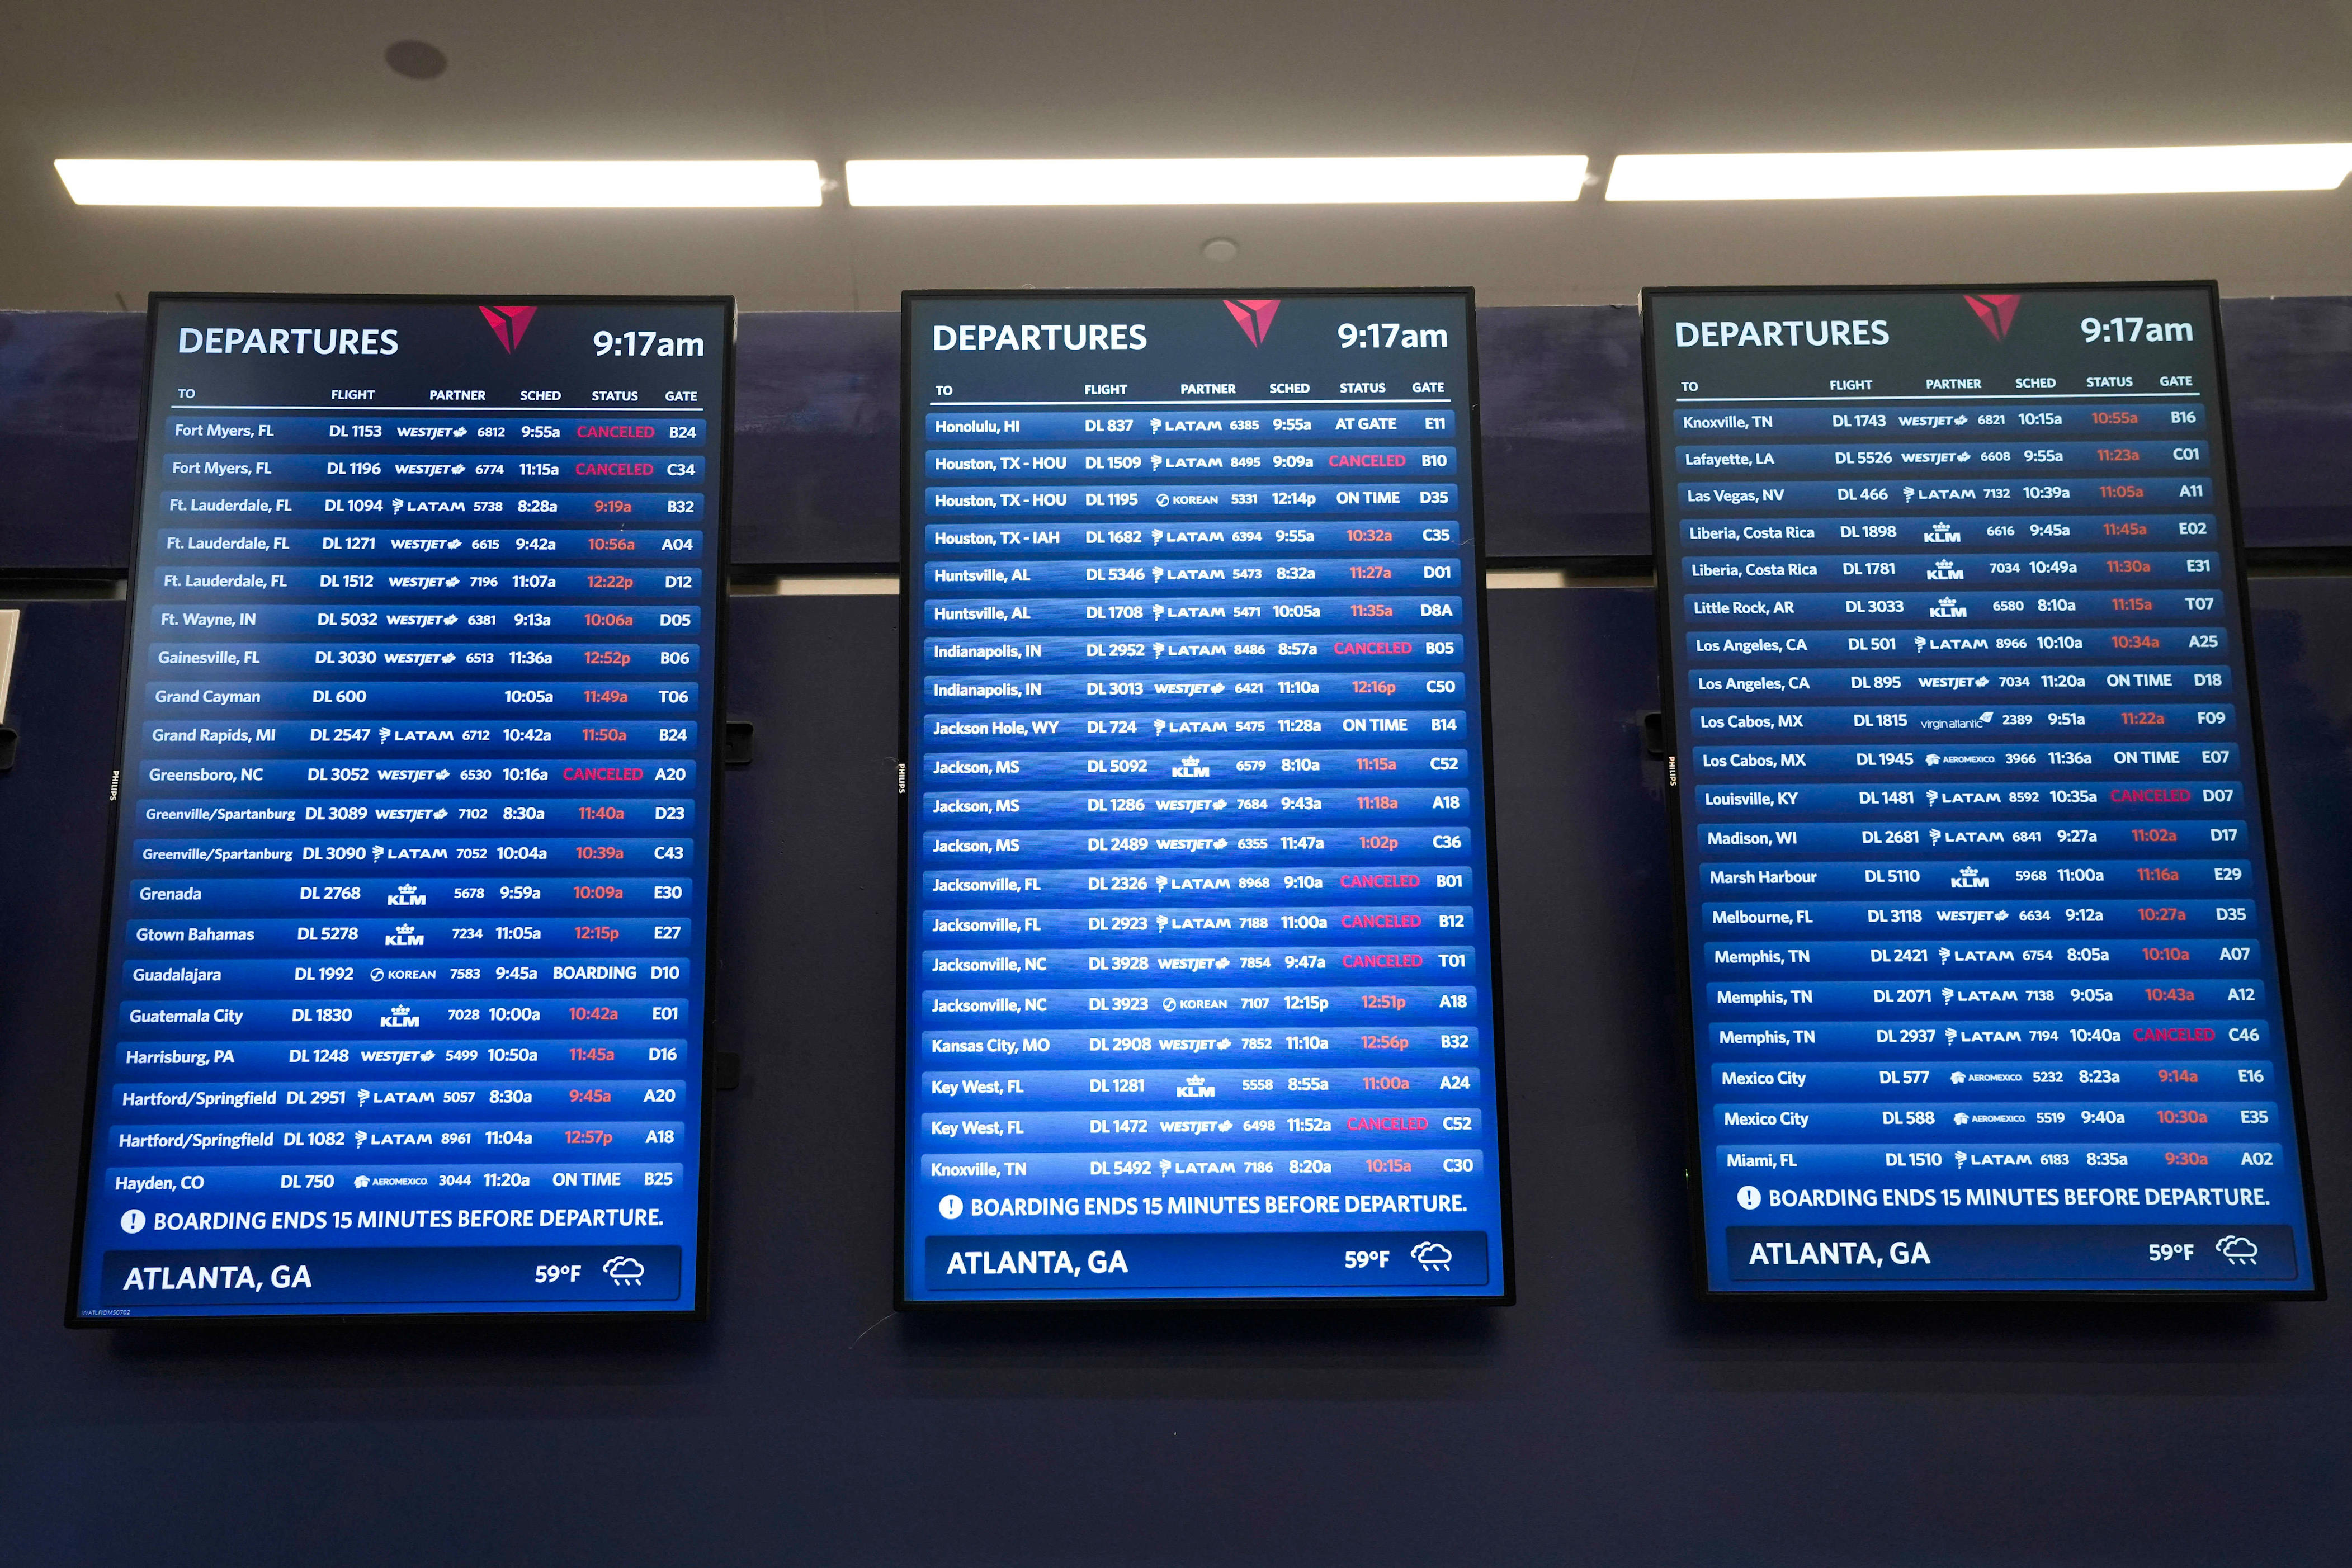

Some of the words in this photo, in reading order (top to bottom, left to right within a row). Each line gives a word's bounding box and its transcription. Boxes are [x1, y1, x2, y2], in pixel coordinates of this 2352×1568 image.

[933, 324, 1147, 351] DEPARTURES
[1338, 323, 1448, 349] 9:17am
[1676, 319, 1890, 347] DEPARTURES
[2081, 317, 2193, 343] 9:17am
[179, 328, 398, 355] DEPARTURES
[593, 330, 704, 357] 9:17am
[935, 385, 953, 396] TO
[1084, 384, 1128, 395] FLIGHT
[1180, 384, 1236, 394] PARTNER
[1269, 383, 1310, 394] SCHED
[1340, 382, 1386, 393] STATUS
[1412, 382, 1445, 393] GATE
[1680, 381, 1698, 391] TO
[1830, 380, 1873, 390] FLIGHT
[1926, 379, 1982, 389] PARTNER
[2015, 377, 2056, 388] SCHED
[2086, 376, 2133, 388] STATUS
[2160, 376, 2193, 386] GATE
[178, 388, 196, 399] TO
[331, 389, 376, 400] FLIGHT
[429, 390, 486, 400] PARTNER
[520, 390, 561, 401] SCHED
[592, 391, 639, 401] STATUS
[665, 391, 698, 402] GATE
[1683, 415, 1749, 430] Knoxville,
[1751, 415, 1773, 428] TN
[1833, 414, 1852, 427] DL
[1854, 414, 1887, 427] 1743
[1898, 415, 1953, 429] WESTJET
[1977, 414, 2005, 425] 6821
[2018, 413, 2062, 425] 10:15a
[2092, 412, 2138, 424] 10:55a
[2171, 411, 2197, 423] B16
[935, 457, 997, 472] Houston,
[999, 457, 1021, 470] TX
[1032, 456, 1067, 470] HOU
[1085, 456, 1105, 469] DL
[1107, 456, 1142, 469] 1509
[1165, 457, 1224, 468] LATAM
[1230, 457, 1261, 467] 8495
[1272, 455, 1314, 468] 9:09a
[1329, 454, 1406, 467] CANCELED
[1421, 454, 1447, 467] B10
[169, 499, 187, 511] Ft.
[191, 498, 272, 513] Lauderdale,
[276, 499, 292, 511] FL
[325, 499, 344, 512] DL
[347, 499, 384, 512] 1094
[407, 502, 466, 512] LATAM
[473, 501, 503, 512] 5738
[517, 500, 558, 513] 8:28a
[594, 500, 631, 512] 9:19a
[668, 500, 694, 513] B32
[158, 650, 240, 666] Gainesville,
[244, 651, 260, 664] FL
[315, 651, 335, 664] DL
[338, 651, 377, 664] 3030
[384, 653, 441, 667] WESTJET
[466, 653, 494, 663] 6513
[509, 651, 552, 664] 11:36a
[584, 651, 631, 667] 12:52p
[660, 651, 689, 664] B06
[1701, 715, 1725, 728] Los
[1727, 715, 1775, 730] Cabos,
[1778, 715, 1803, 727] MX
[1854, 714, 1874, 727] DL
[1876, 714, 1907, 727] 1815
[2002, 714, 2033, 725] 2389
[2048, 712, 2085, 725] 9:51a
[2121, 712, 2165, 725] 11:22a
[2197, 711, 2226, 724] F09
[933, 760, 993, 776] Jackson,
[995, 760, 1020, 773] MS
[1087, 758, 1108, 773] DL
[1109, 759, 1148, 773] 5092
[1172, 766, 1210, 778] KLM
[1236, 759, 1267, 771] 6579
[1281, 758, 1320, 772] 8:10a
[1356, 757, 1397, 771] 11:15a
[1430, 757, 1458, 771] C52
[1668, 755, 1677, 787] PHILIPS
[109, 769, 120, 801] PHILIPS
[932, 957, 1022, 973] Jacksonville,
[1024, 957, 1047, 971] NC
[1089, 956, 1109, 970] DL
[1111, 956, 1149, 970] 3928
[1157, 958, 1215, 972] WESTJET
[1240, 957, 1272, 969] 7854
[1284, 955, 1326, 969] 9:47a
[1342, 954, 1423, 968] CANCELED
[1438, 954, 1466, 967] T01
[133, 967, 221, 984] Guadalajara
[295, 967, 315, 980] DL
[318, 967, 354, 980] 1992
[388, 970, 436, 979] KOREAN
[450, 968, 481, 979] 7583
[495, 966, 537, 980] 9:45a
[553, 966, 637, 980] BOARDING
[650, 966, 680, 980] D10
[1720, 1029, 1790, 1047] Memphis,
[1792, 1030, 1815, 1043] TN
[1876, 1029, 1897, 1043] DL
[1900, 1029, 1936, 1043] 2937
[1961, 1031, 2022, 1042] LATAM
[2029, 1030, 2059, 1041] 7194
[2069, 1028, 2121, 1042] 10:40a
[2133, 1028, 2215, 1041] CANCELED
[2228, 1028, 2260, 1042] C46
[115, 1175, 177, 1193] Hayden,
[181, 1175, 205, 1190] CO
[281, 1174, 301, 1188] DL
[305, 1174, 335, 1188] 750
[438, 1174, 472, 1186] 3044
[483, 1173, 530, 1187] 11:20a
[552, 1172, 578, 1187] ON
[580, 1172, 621, 1186] TIME
[644, 1172, 673, 1186] B25
[971, 1197, 1079, 1217] BOARDING
[1085, 1197, 1138, 1215] ENDS
[1142, 1197, 1163, 1215] 15
[1168, 1196, 1260, 1215] MINUTES
[1265, 1195, 1340, 1213] BEFORE
[1345, 1194, 1467, 1213] DEPARTURE.
[1769, 1189, 1877, 1207] BOARDING
[1882, 1189, 1937, 1206] ENDS
[1940, 1189, 1961, 1206] 15
[1967, 1188, 2060, 1206] MINUTES
[2064, 1188, 2140, 1206] BEFORE
[2145, 1188, 2270, 1206] DEPARTURE.
[154, 1212, 266, 1231] BOARDING
[272, 1211, 327, 1229] ENDS
[332, 1211, 352, 1229] 15
[357, 1210, 452, 1228] MINUTES
[458, 1209, 534, 1227] BEFORE
[540, 1208, 663, 1226] DEPARTURE.
[946, 1250, 1081, 1277] ATLANTA,
[1088, 1250, 1128, 1274] GA
[1749, 1241, 1883, 1268] ATLANTA,
[1890, 1241, 1931, 1265] GA
[122, 1265, 263, 1292] ATLANTA,
[271, 1265, 312, 1288] GA
